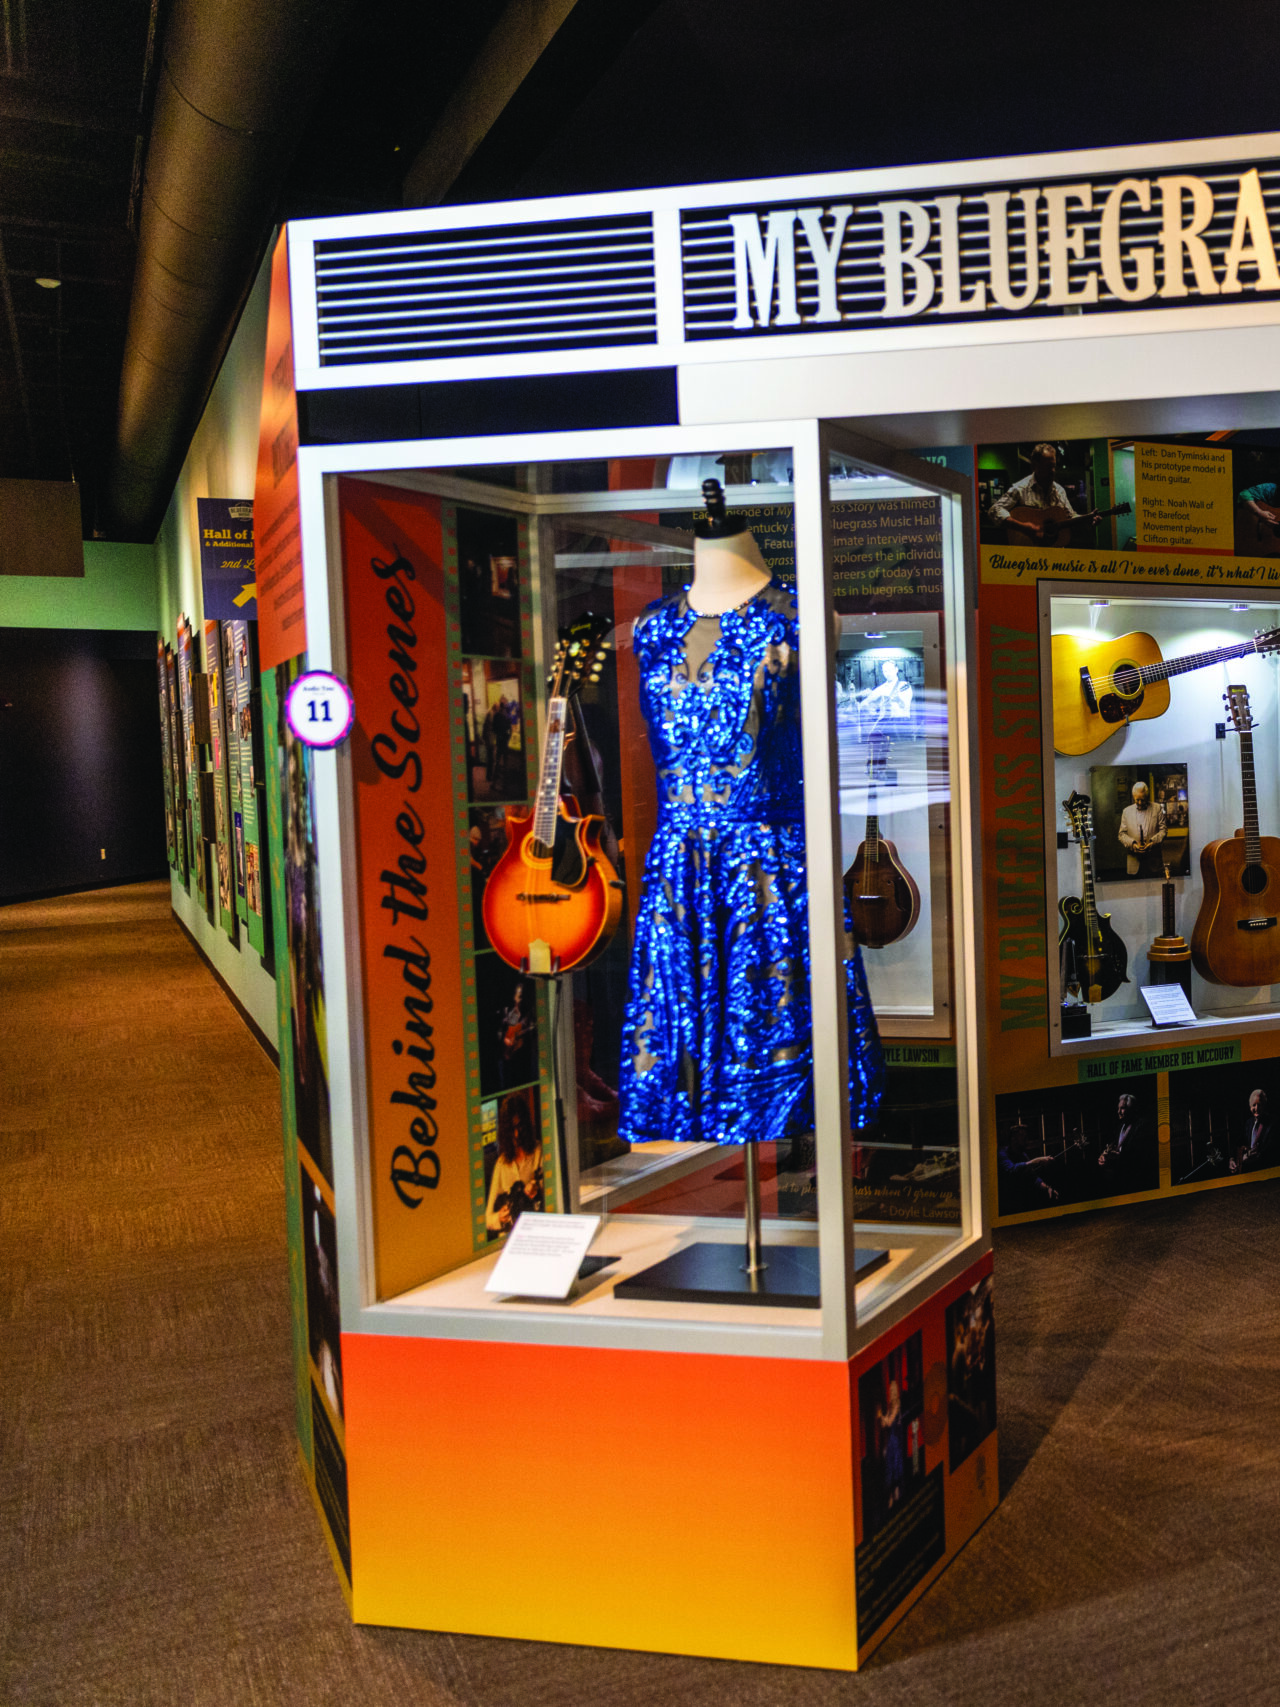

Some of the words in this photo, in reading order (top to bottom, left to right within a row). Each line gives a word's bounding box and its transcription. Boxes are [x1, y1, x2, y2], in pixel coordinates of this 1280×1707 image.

[730, 204, 853, 329] MY
[1141, 447, 1158, 457] Left:
[1161, 449, 1176, 458] Dan
[1178, 450, 1210, 461] Tyminski
[1211, 454, 1225, 463] and
[1141, 460, 1153, 469] his
[1154, 462, 1191, 472] prototype
[1193, 465, 1216, 473] model
[1217, 466, 1226, 474] #1
[1142, 472, 1167, 482] Martin
[1168, 475, 1192, 485] guitar.
[877, 503, 899, 512] was
[1142, 497, 1165, 508] Right:
[1168, 499, 1187, 508] Noah
[1189, 500, 1205, 509] Wall
[1206, 501, 1214, 509] of
[1143, 510, 1157, 519] The
[1158, 511, 1190, 520] Barefoot
[746, 522, 789, 535] entucky
[832, 518, 878, 531] luegrass
[880, 516, 912, 528] Music
[914, 514, 935, 526] Hall
[1143, 522, 1184, 532] Movement
[1185, 524, 1204, 534] plays
[1205, 526, 1218, 534] her
[203, 529, 232, 540] Hall
[234, 530, 248, 540] of
[866, 532, 923, 545] interviews
[1143, 534, 1169, 544] Clifton
[1170, 536, 1194, 545] guitar.
[220, 559, 243, 569] 2nd
[989, 553, 1049, 572] Bluegrass
[1052, 560, 1086, 574] music
[1087, 559, 1100, 574] is
[1101, 558, 1118, 574] all
[1119, 560, 1147, 576] I've
[1148, 565, 1172, 577] ever
[1172, 562, 1204, 580] done,
[1206, 564, 1226, 579] it's
[1226, 565, 1256, 581] what
[1256, 566, 1266, 582] I
[849, 585, 859, 596] in
[862, 584, 914, 598] bluegrass
[371, 543, 424, 793] Scenes
[991, 624, 1039, 740] STORY
[307, 700, 332, 722] 11
[380, 797, 430, 926] the
[994, 752, 1046, 963] BLUEGRASS
[1001, 973, 1048, 1035] MY
[903, 1047, 940, 1063] LAWSON
[1087, 1063, 1107, 1078] HALL
[1109, 1061, 1119, 1075] OF
[1121, 1057, 1143, 1073] FAME
[1145, 1053, 1179, 1070] MEMBER
[1181, 1051, 1195, 1065] DEL
[1197, 1045, 1235, 1063] MCCOURY
[384, 935, 441, 1210] Behind
[889, 1204, 920, 1219] Doyle
